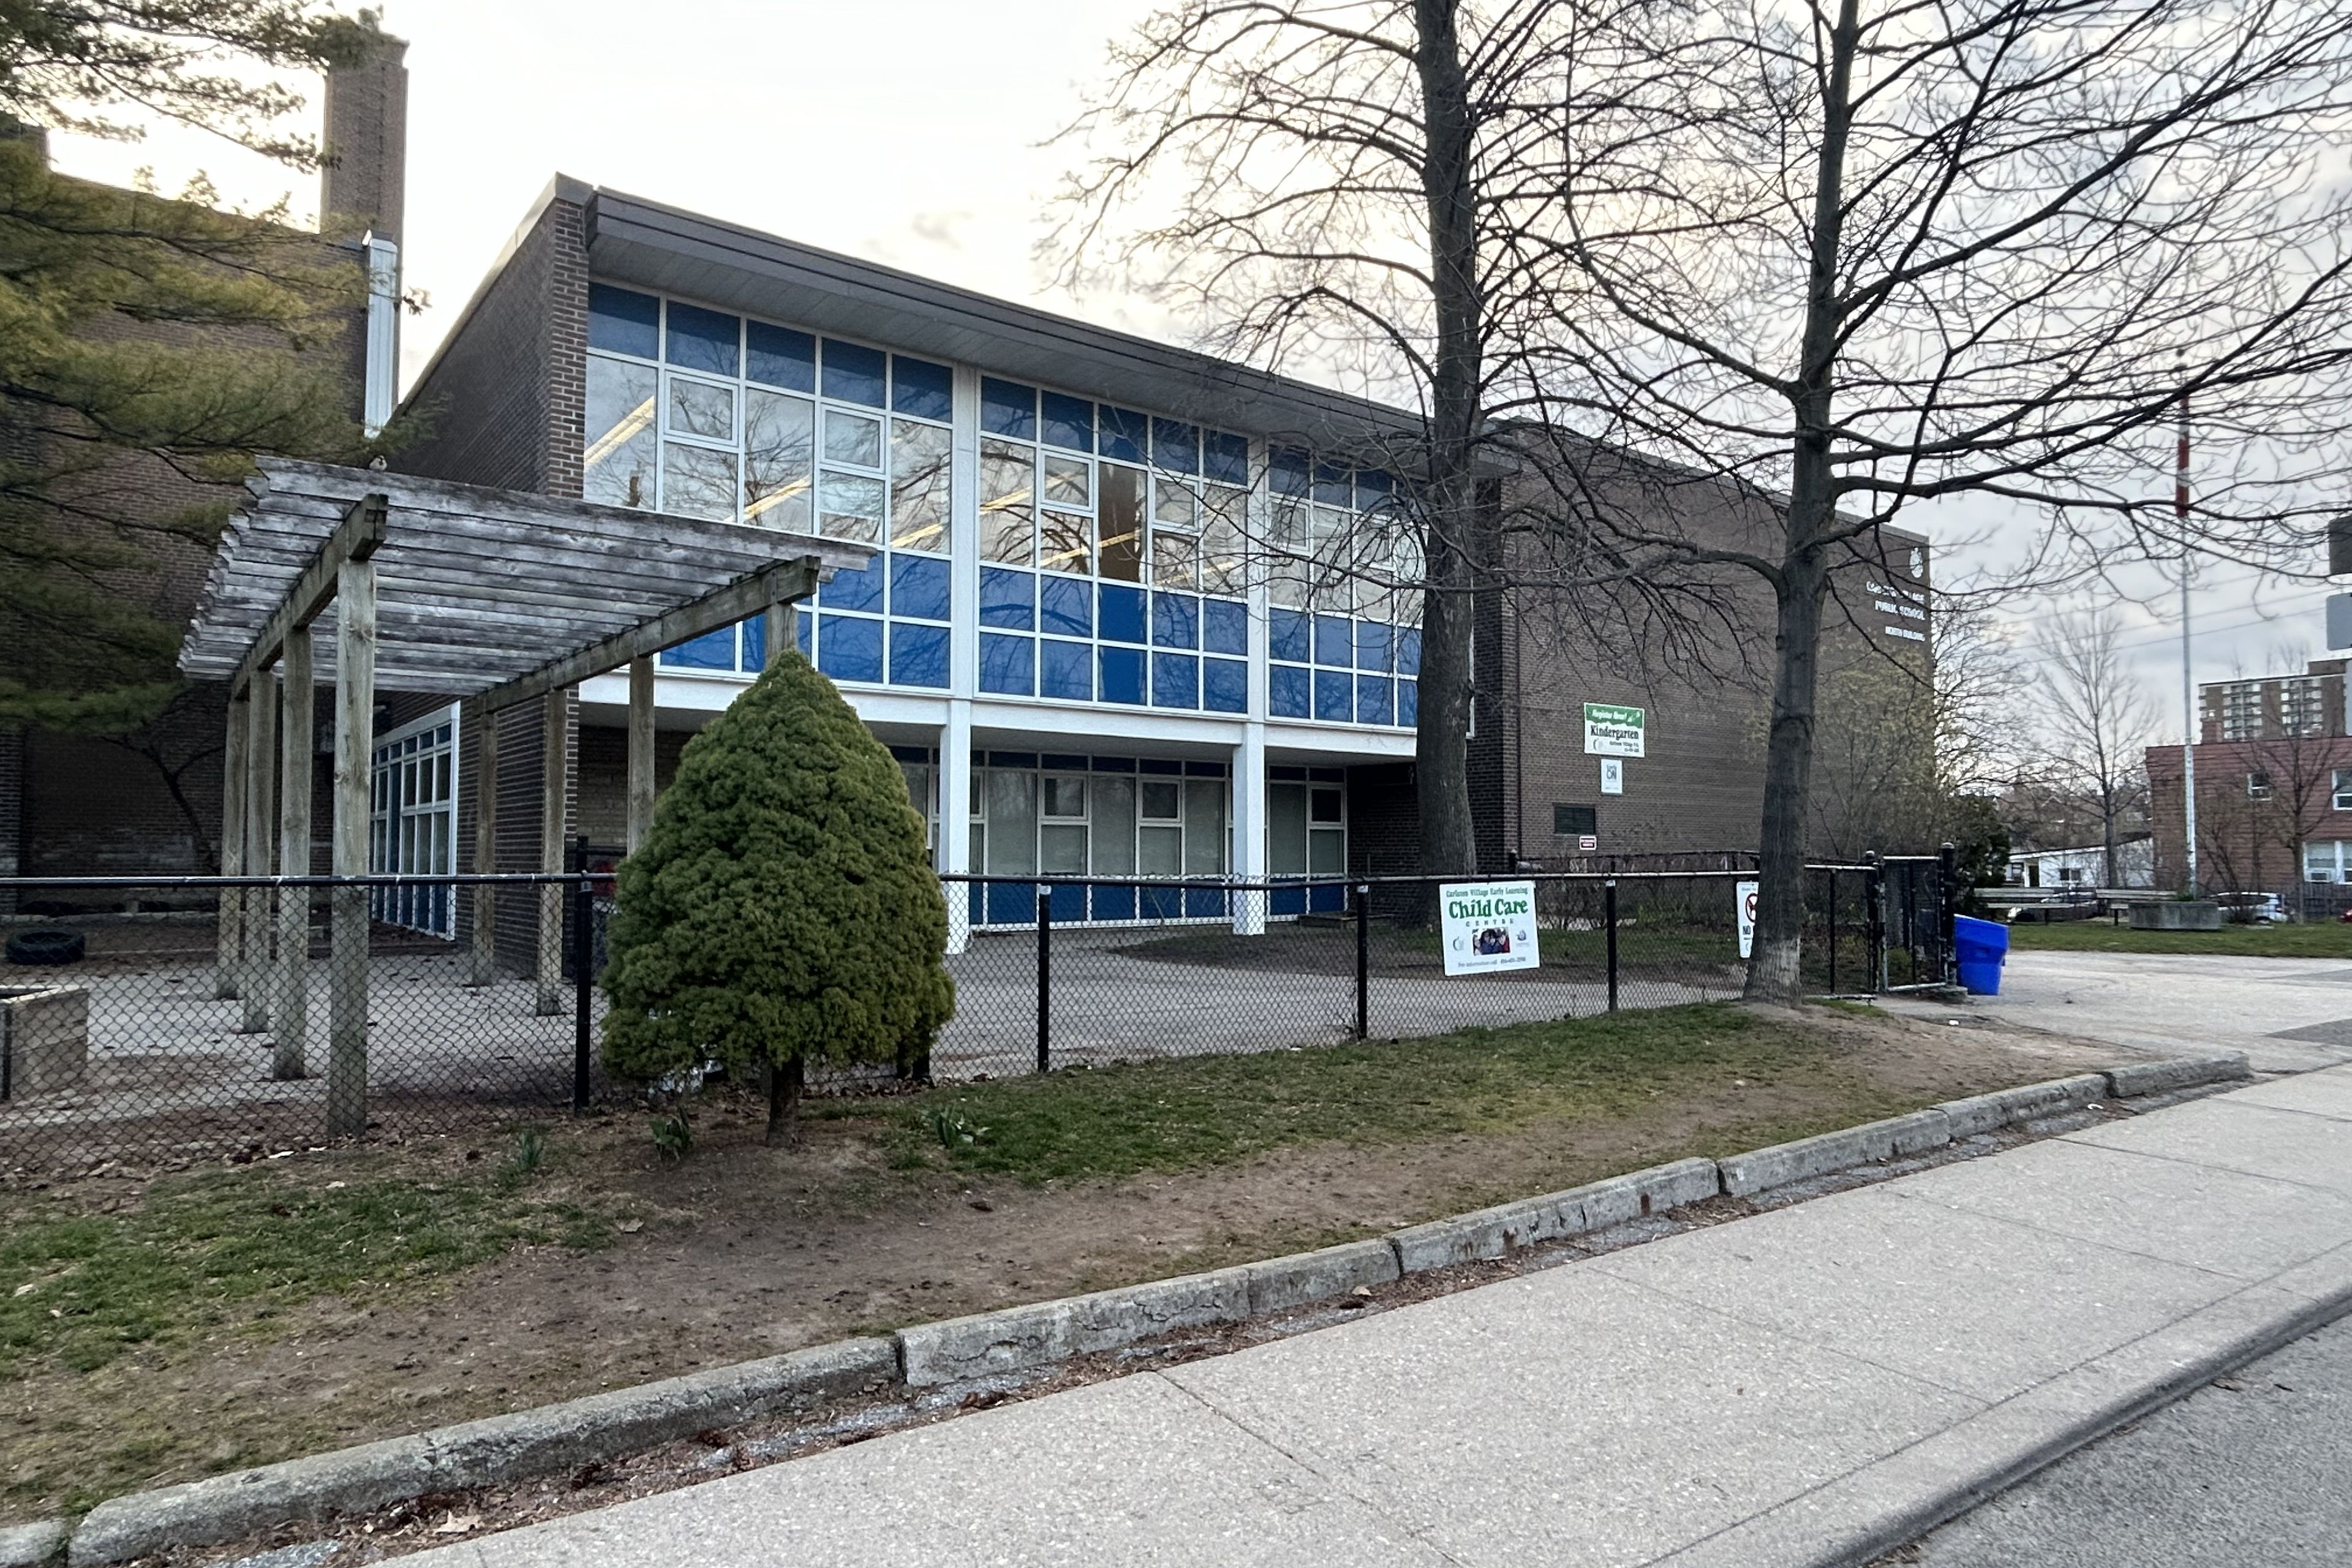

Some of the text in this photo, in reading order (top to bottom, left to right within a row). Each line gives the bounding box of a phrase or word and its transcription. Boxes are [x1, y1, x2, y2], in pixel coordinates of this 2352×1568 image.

[1590, 725, 1639, 741] Kindergarten
[1470, 888, 1488, 897] Village
[1490, 888, 1504, 897] Early
[1449, 898, 1528, 919] Child Care
